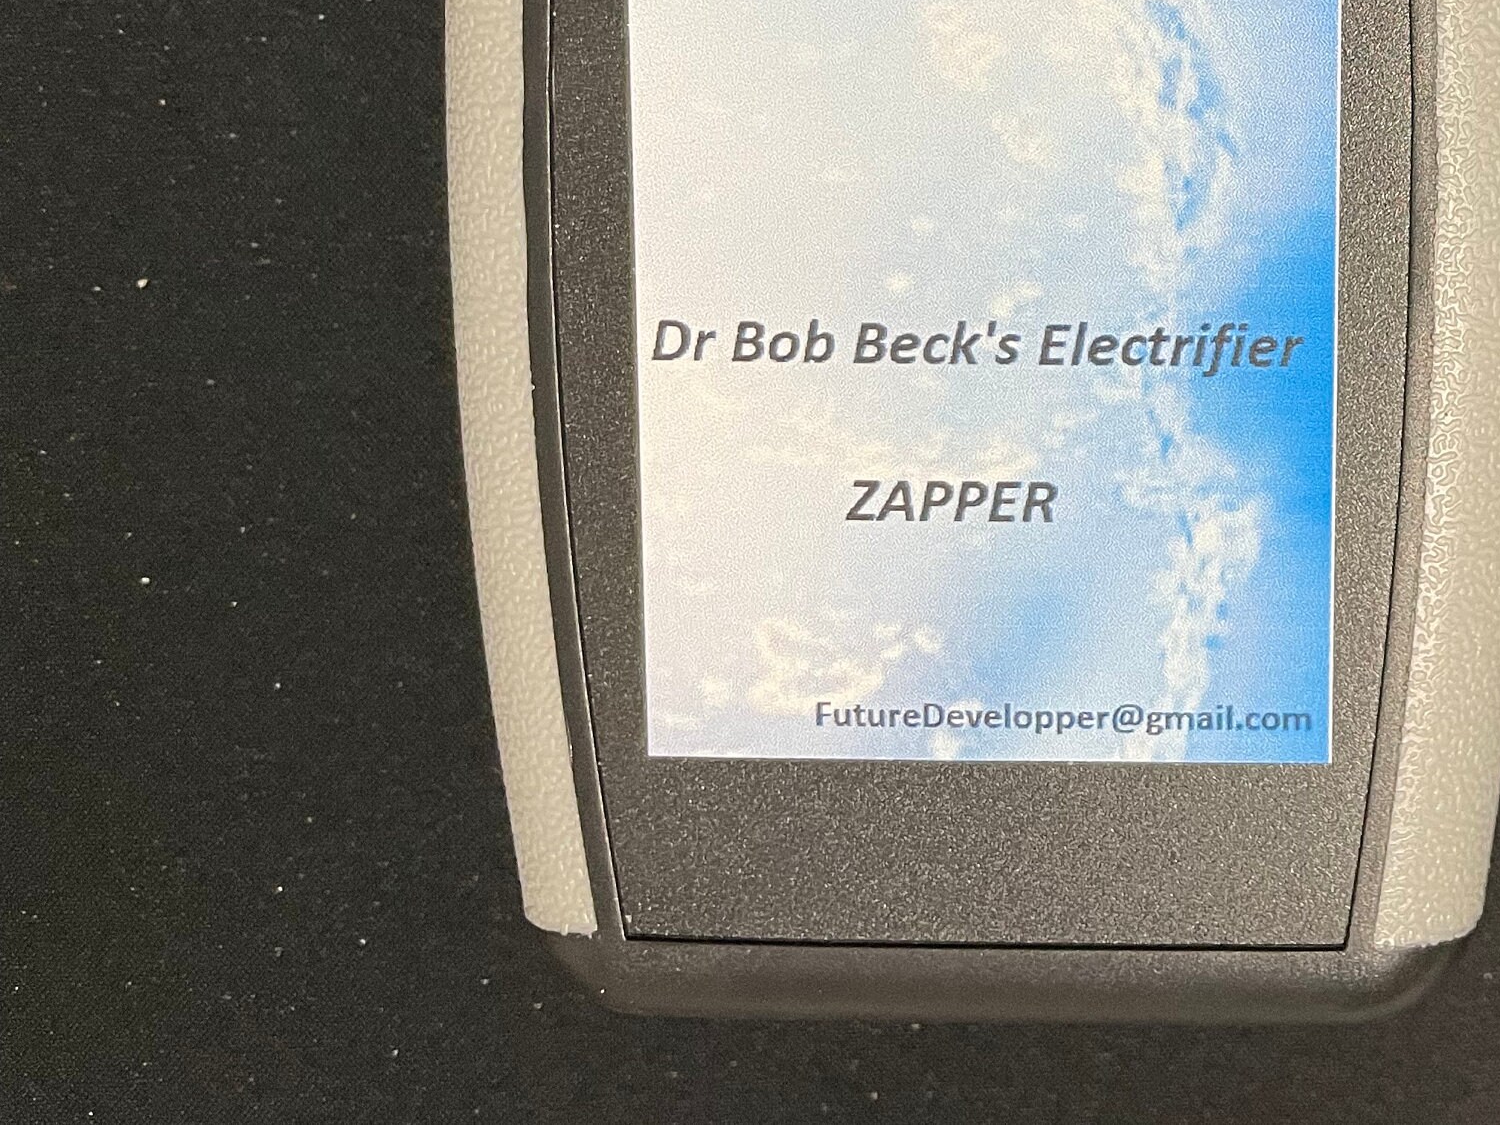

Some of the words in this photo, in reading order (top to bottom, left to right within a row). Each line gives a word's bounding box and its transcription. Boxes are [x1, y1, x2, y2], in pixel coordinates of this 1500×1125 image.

[651, 319, 717, 362] Dr
[731, 318, 835, 364] Bob
[852, 320, 1021, 365] Beck's
[1038, 321, 1304, 378] Electrifier
[845, 479, 1058, 523] ZAPPER
[815, 701, 1311, 736] FutureDevelopper@gmail.com
